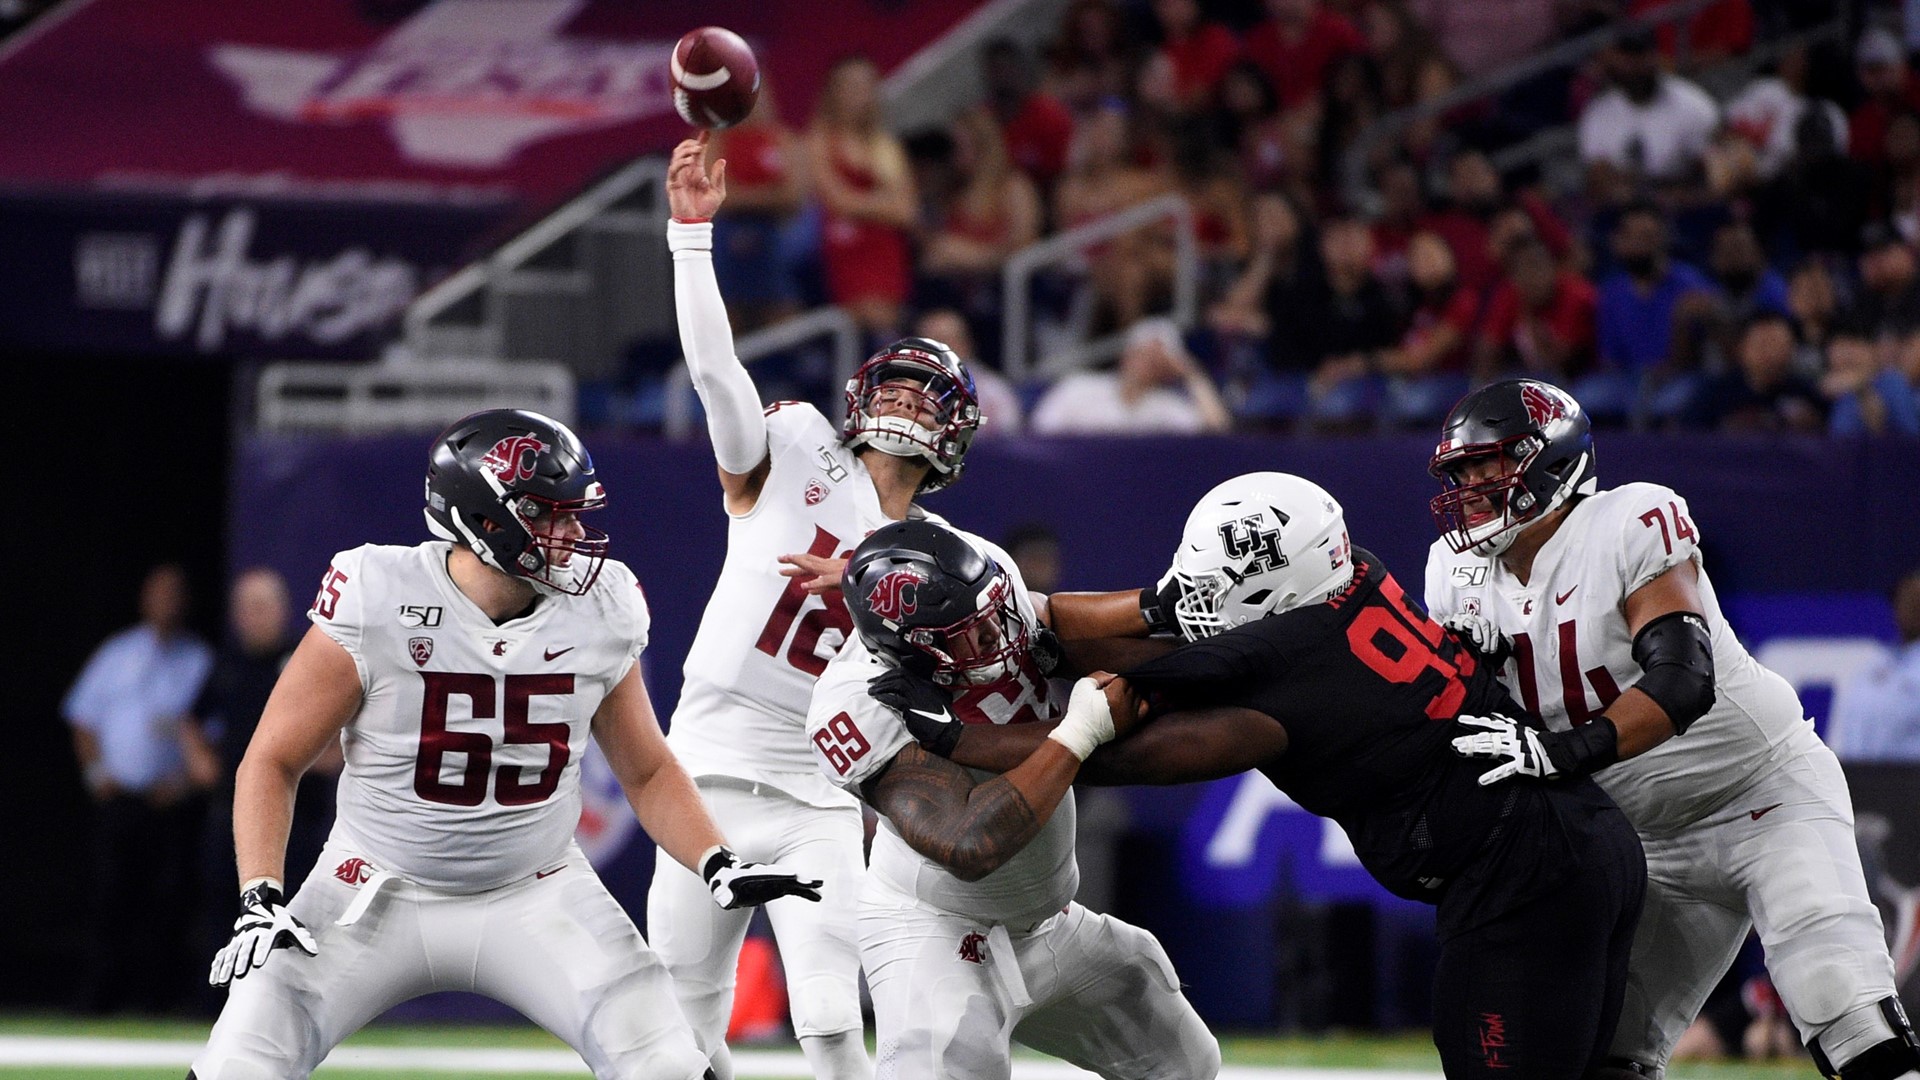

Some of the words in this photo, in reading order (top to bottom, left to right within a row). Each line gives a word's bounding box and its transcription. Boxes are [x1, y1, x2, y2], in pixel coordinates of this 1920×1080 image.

[1638, 501, 1697, 555] 74
[1452, 566, 1488, 588] 150
[399, 605, 443, 628] 150
[1346, 572, 1476, 720] 95
[414, 671, 575, 807] 65
[812, 711, 871, 776] 69
